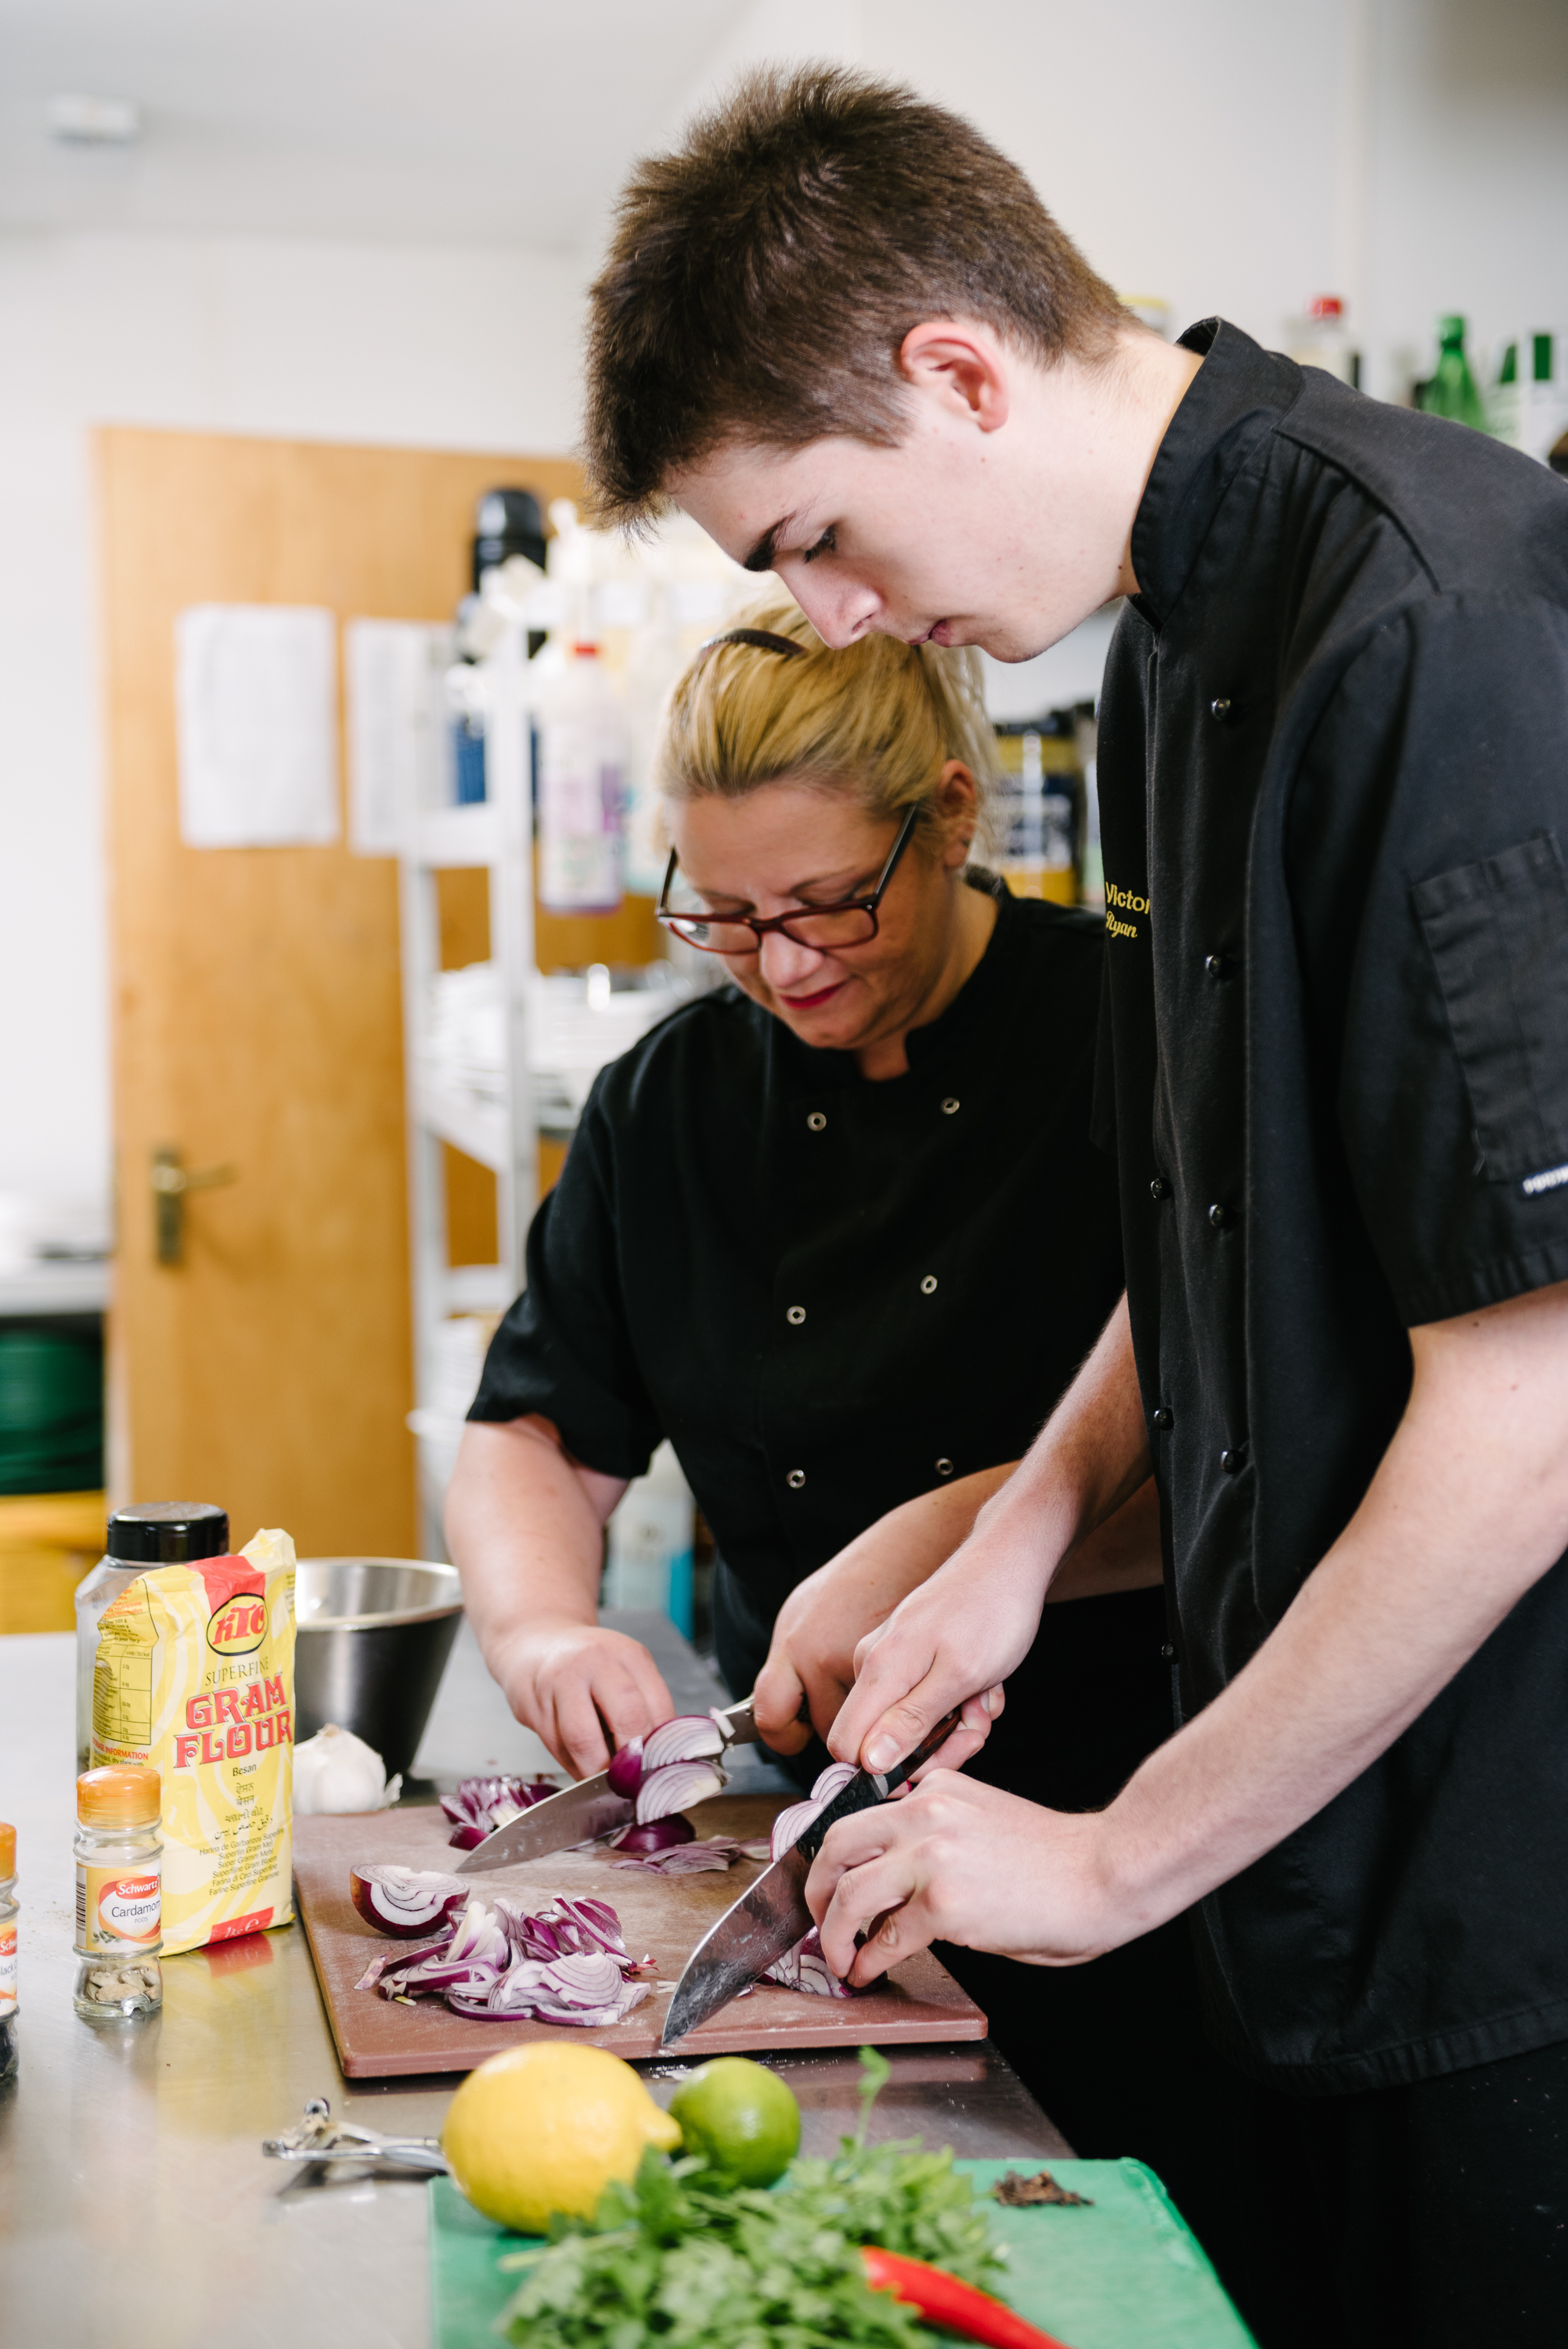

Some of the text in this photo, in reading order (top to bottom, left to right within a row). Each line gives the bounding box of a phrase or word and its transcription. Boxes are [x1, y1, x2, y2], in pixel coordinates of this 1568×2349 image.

[1105, 911, 1137, 938] Ryan
[212, 1604, 265, 1645] KTC
[206, 1657, 269, 1687] SUPERFINE
[186, 1672, 287, 1730] GRAM
[174, 1708, 294, 1768] FLOUR
[105, 1746, 149, 1760] INFORMATION
[232, 1764, 257, 1777] Besan
[218, 1849, 245, 1860] Superfin
[246, 1845, 261, 1854] Gram
[221, 1842, 229, 1851] de
[230, 1836, 262, 1849] Garbanzos
[218, 1848, 273, 1869] Super Gramm Mehl
[244, 1860, 261, 1871] Gram
[212, 1875, 232, 1887] Farina
[233, 1874, 239, 1882] di
[253, 1864, 278, 1876] Superfine
[118, 1880, 158, 1896] Schwartz
[209, 1886, 229, 1896] Farine
[230, 1878, 257, 1892] Superfine
